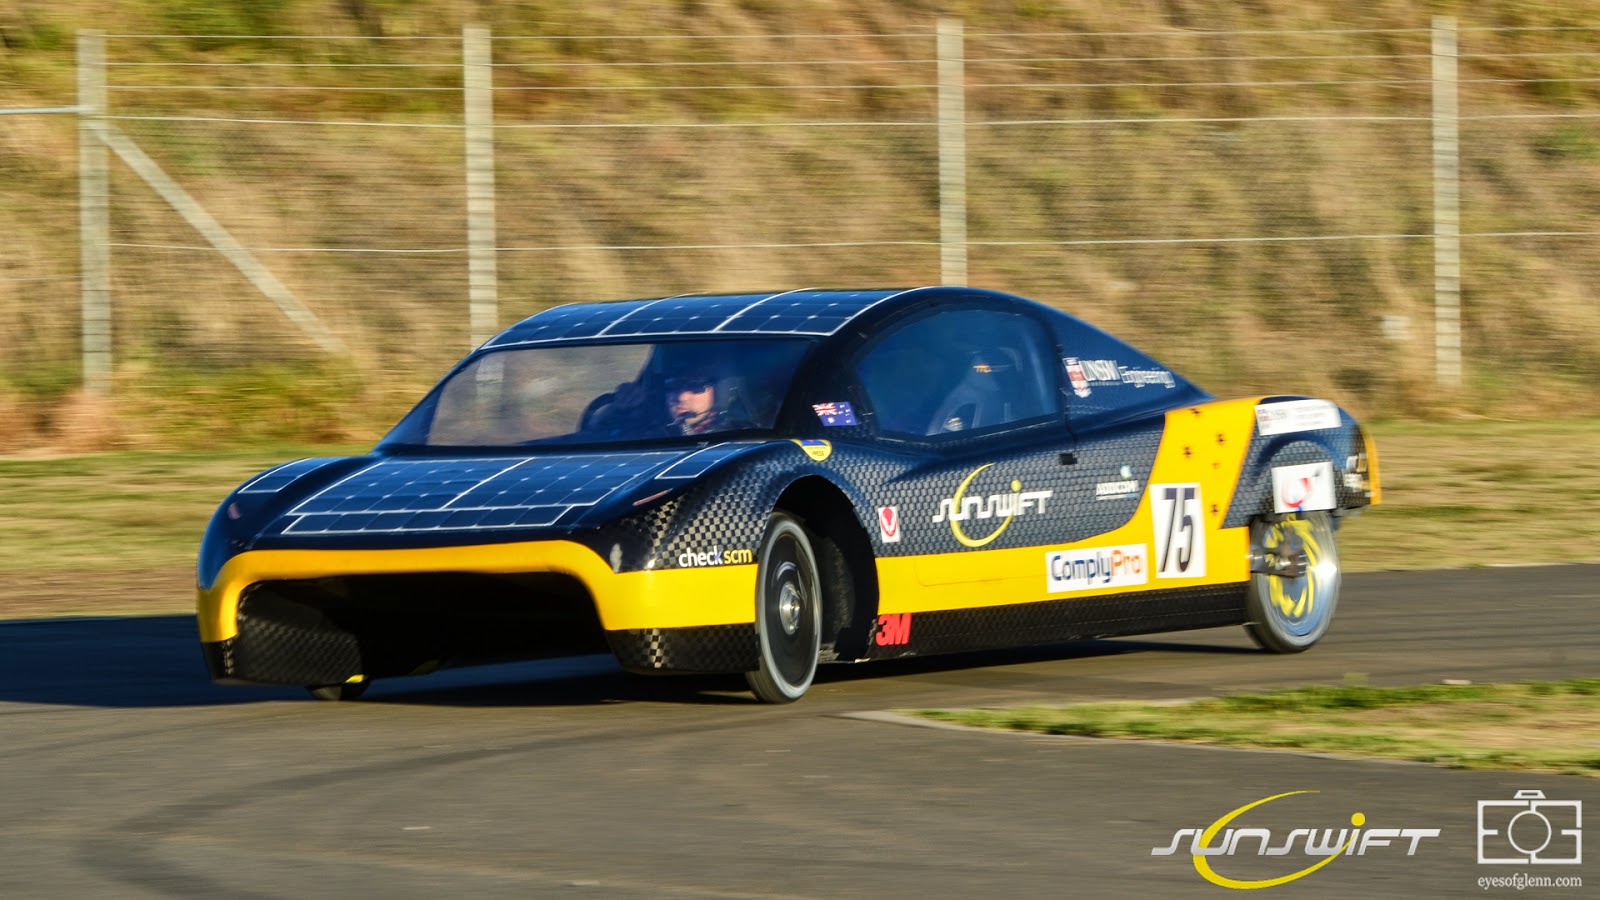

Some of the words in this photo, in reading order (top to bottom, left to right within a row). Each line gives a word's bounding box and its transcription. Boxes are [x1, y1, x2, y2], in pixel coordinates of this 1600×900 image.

[1159, 487, 1197, 573] 75
[1050, 550, 1141, 583] ComplyPro
[875, 612, 912, 646] 3M
